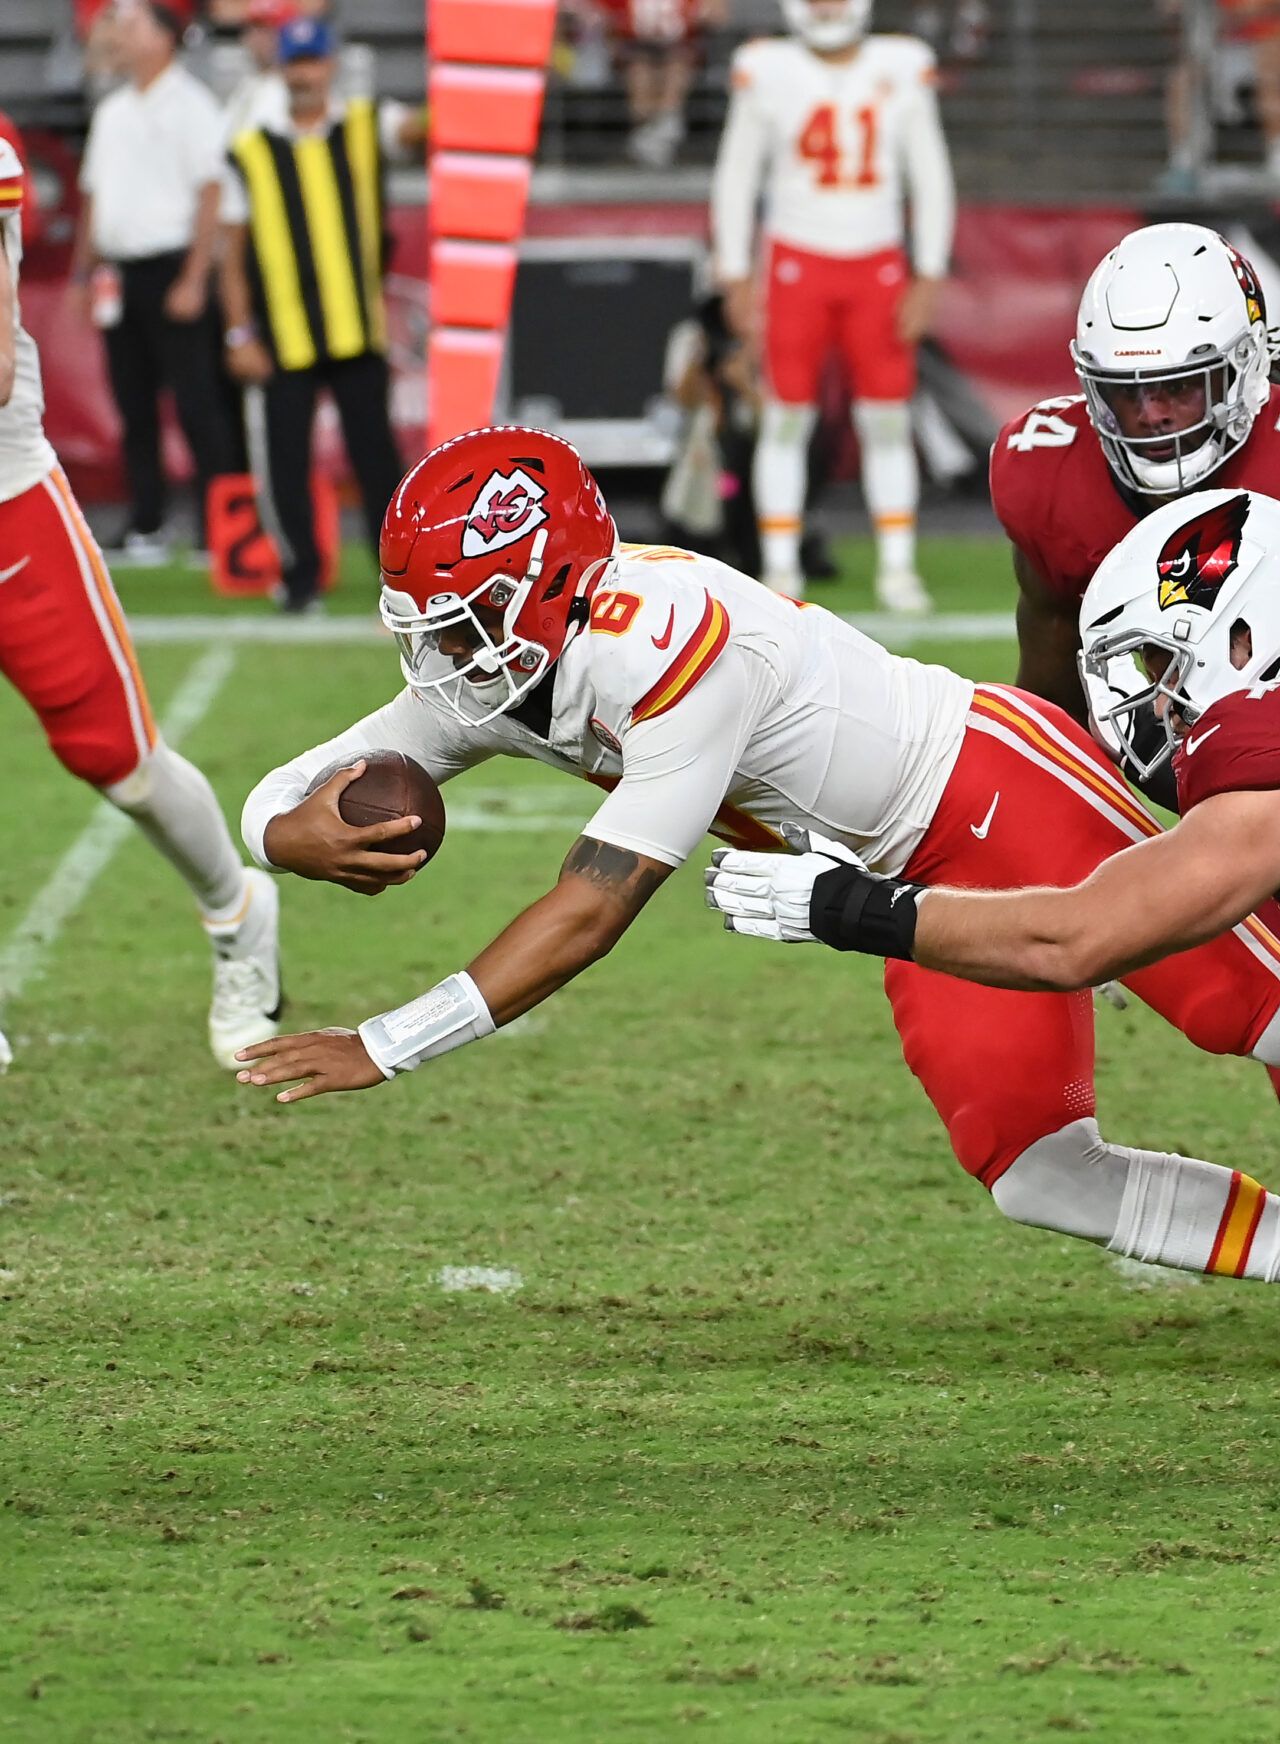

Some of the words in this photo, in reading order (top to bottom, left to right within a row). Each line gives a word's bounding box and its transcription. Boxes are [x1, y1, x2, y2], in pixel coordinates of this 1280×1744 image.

[798, 101, 877, 189] 41
[1114, 349, 1162, 357] CARDINALS
[468, 484, 535, 544] KC
